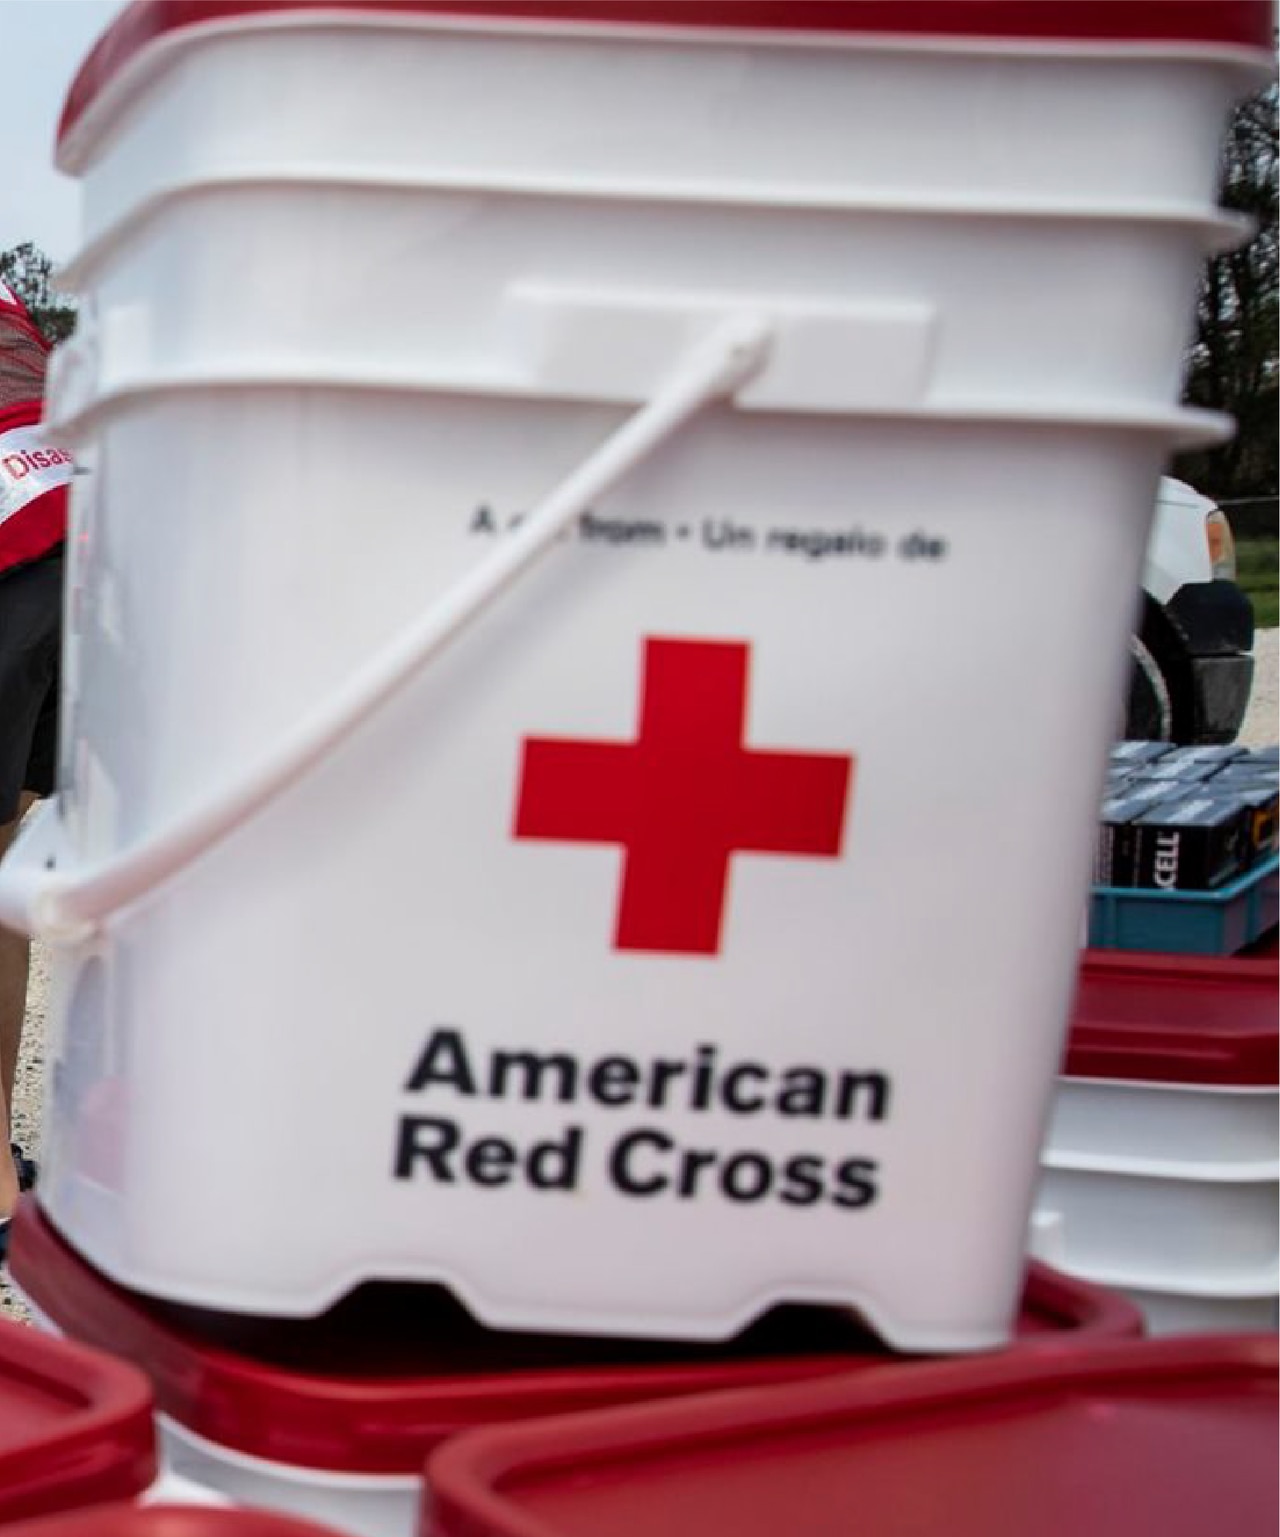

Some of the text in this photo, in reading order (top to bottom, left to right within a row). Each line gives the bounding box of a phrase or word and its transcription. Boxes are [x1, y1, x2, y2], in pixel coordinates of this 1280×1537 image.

[701, 520, 756, 551] Un
[767, 529, 886, 561] regalo
[898, 532, 946, 561] de
[1154, 832, 1180, 890] CELL
[403, 1027, 892, 1123] American
[393, 1114, 883, 1211] Red Cross
